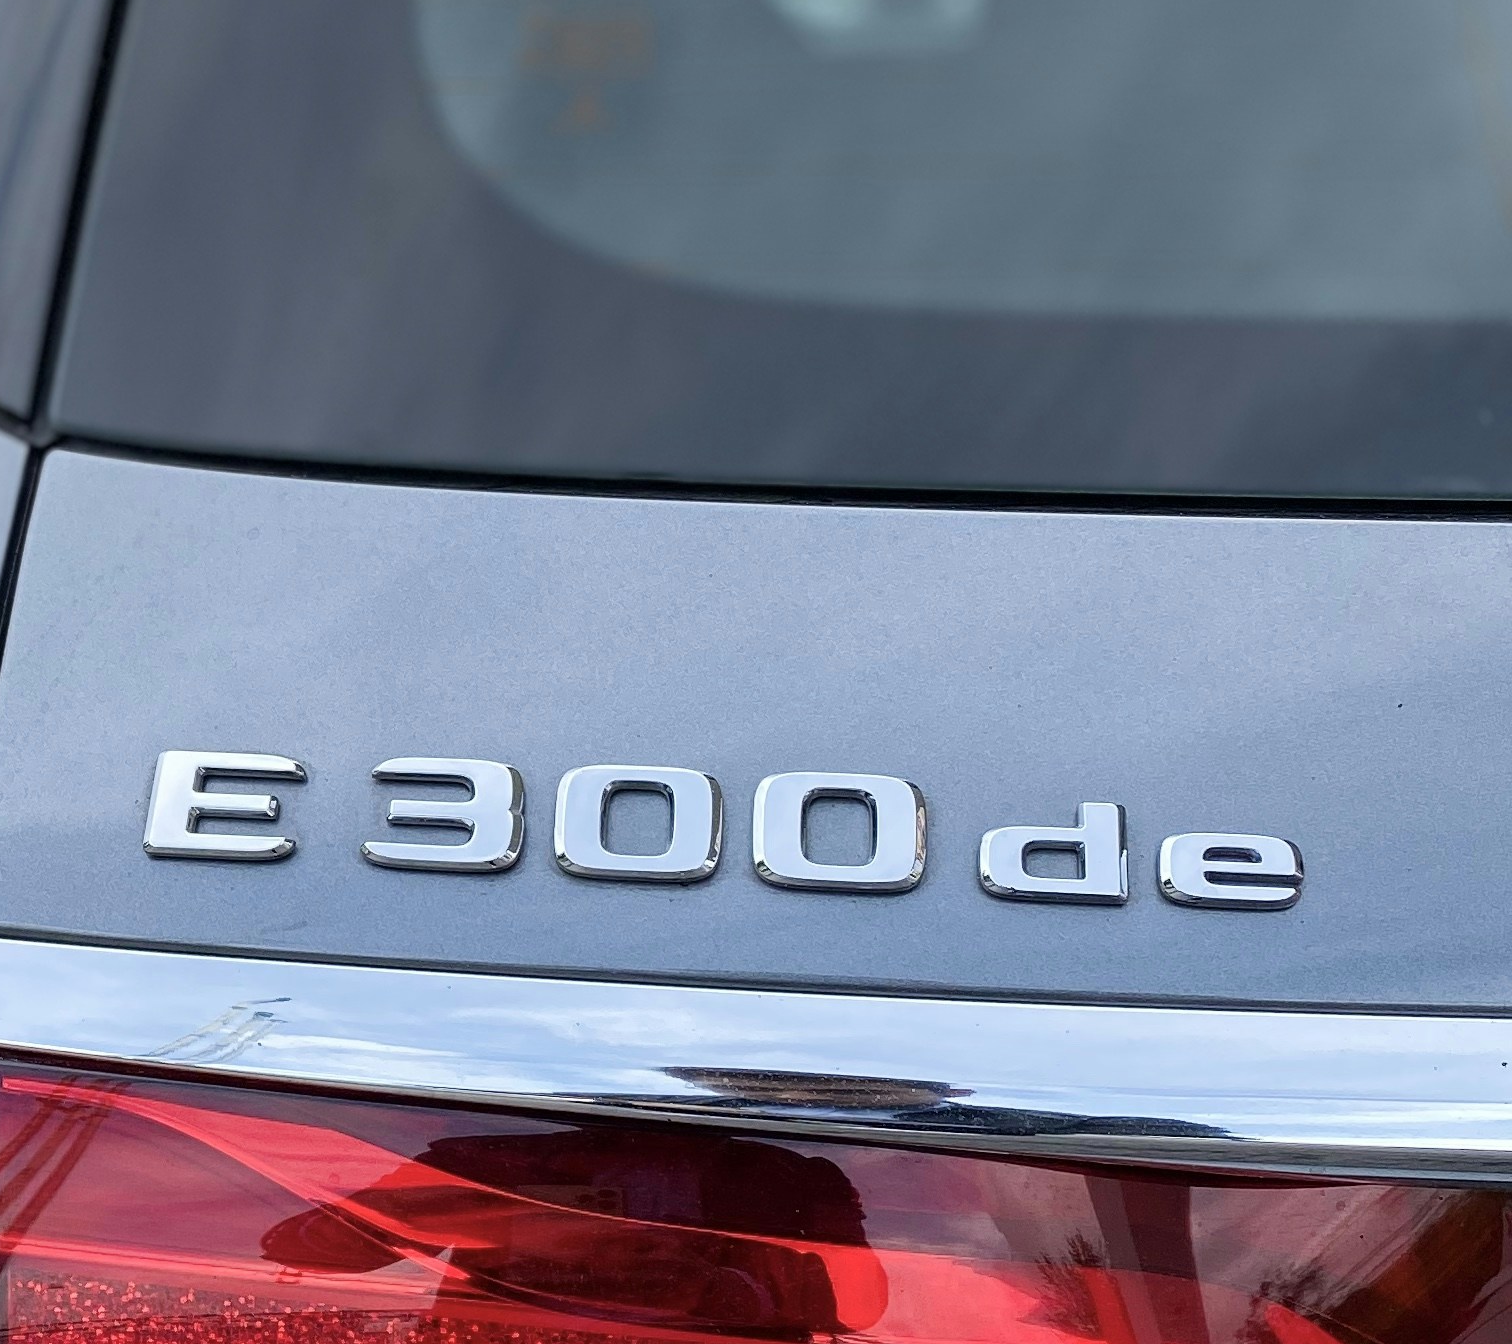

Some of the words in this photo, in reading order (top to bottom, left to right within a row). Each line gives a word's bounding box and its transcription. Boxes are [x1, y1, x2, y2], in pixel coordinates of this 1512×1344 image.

[143, 750, 308, 861] E
[361, 757, 929, 893] 300
[977, 802, 1305, 911] de
